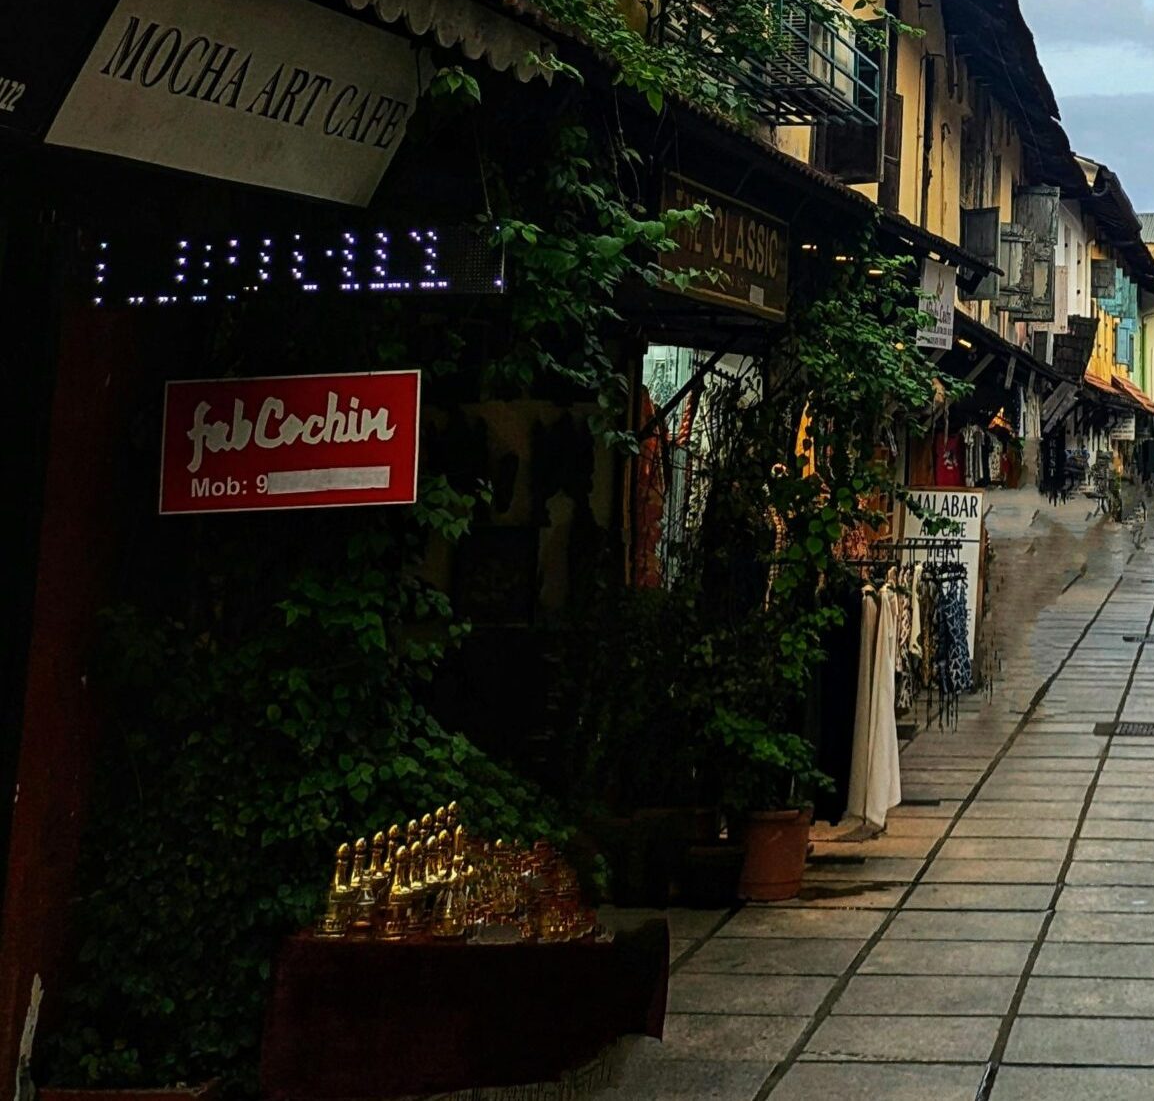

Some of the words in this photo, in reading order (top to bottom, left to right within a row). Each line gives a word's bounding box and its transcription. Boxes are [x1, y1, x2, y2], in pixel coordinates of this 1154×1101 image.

[100, 16, 252, 109] MOCHA
[246, 63, 333, 127] ART
[323, 85, 409, 149] CAFE
[711, 205, 779, 279] CLASSIC
[190, 476, 247, 498] Mob:
[906, 493, 979, 518] MALABAR
